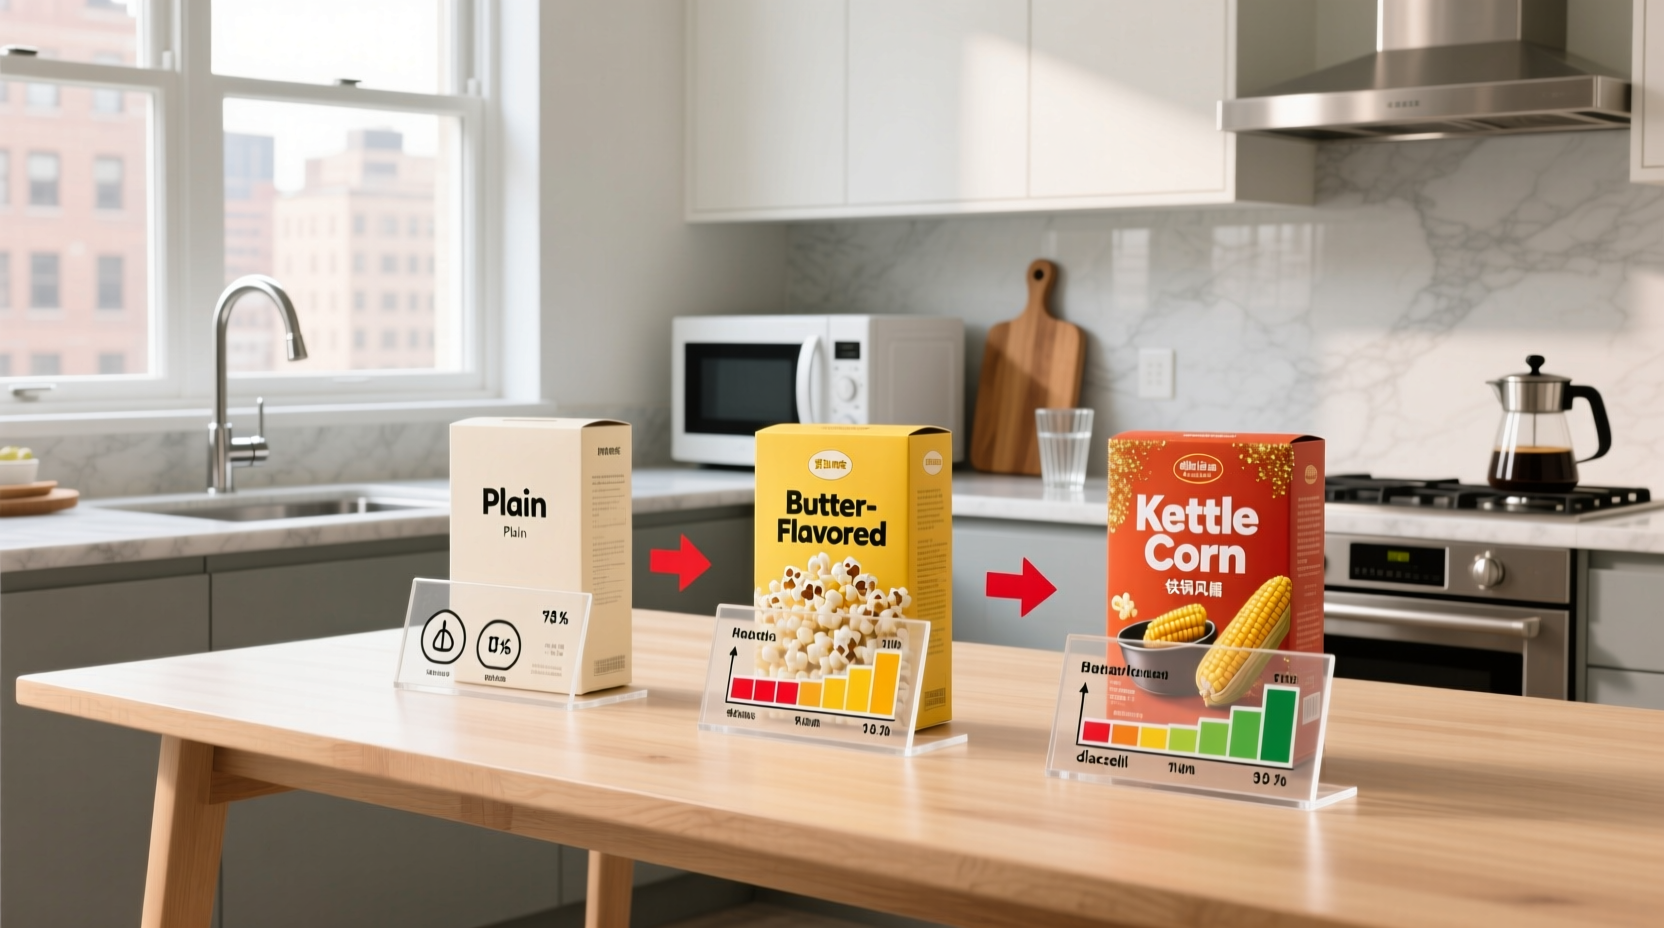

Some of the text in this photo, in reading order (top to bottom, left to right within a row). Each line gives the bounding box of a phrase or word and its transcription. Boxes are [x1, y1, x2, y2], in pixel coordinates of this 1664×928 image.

[483, 487, 547, 518] Plain
[786, 489, 877, 517] Butter-
[1136, 494, 1259, 536] Kettle
[503, 525, 527, 539] Plain
[777, 518, 887, 547] Flavored
[1144, 533, 1246, 574] Corn
